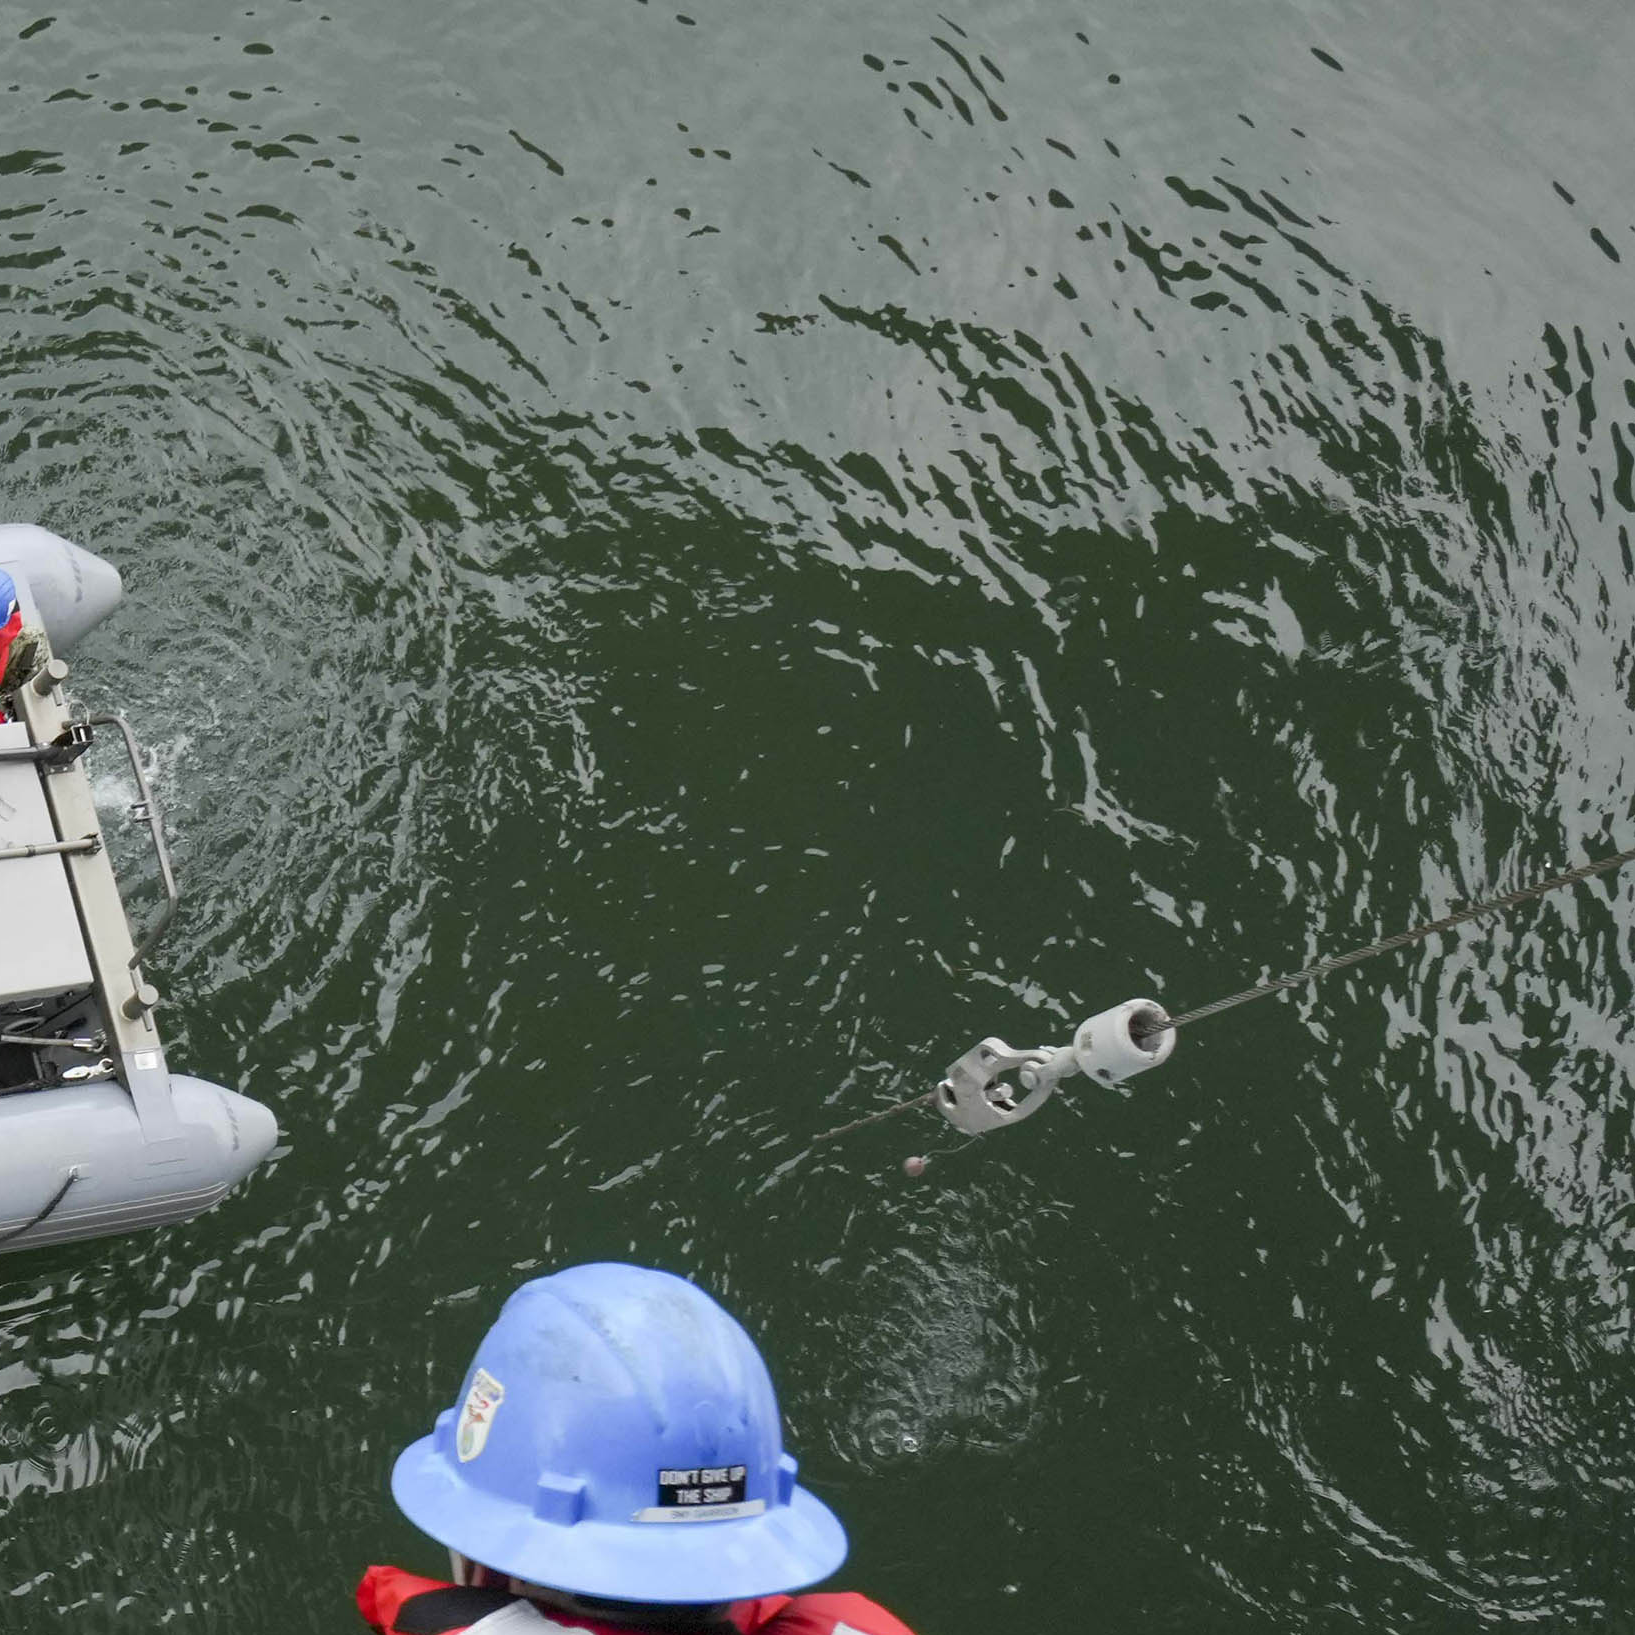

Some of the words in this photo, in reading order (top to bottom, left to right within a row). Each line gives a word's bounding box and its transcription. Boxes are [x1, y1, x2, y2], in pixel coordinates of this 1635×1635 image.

[659, 1470, 699, 1485] DON'T
[701, 1468, 728, 1484] GIVE
[676, 1489, 701, 1503] THE
[703, 1487, 731, 1502] SHIP
